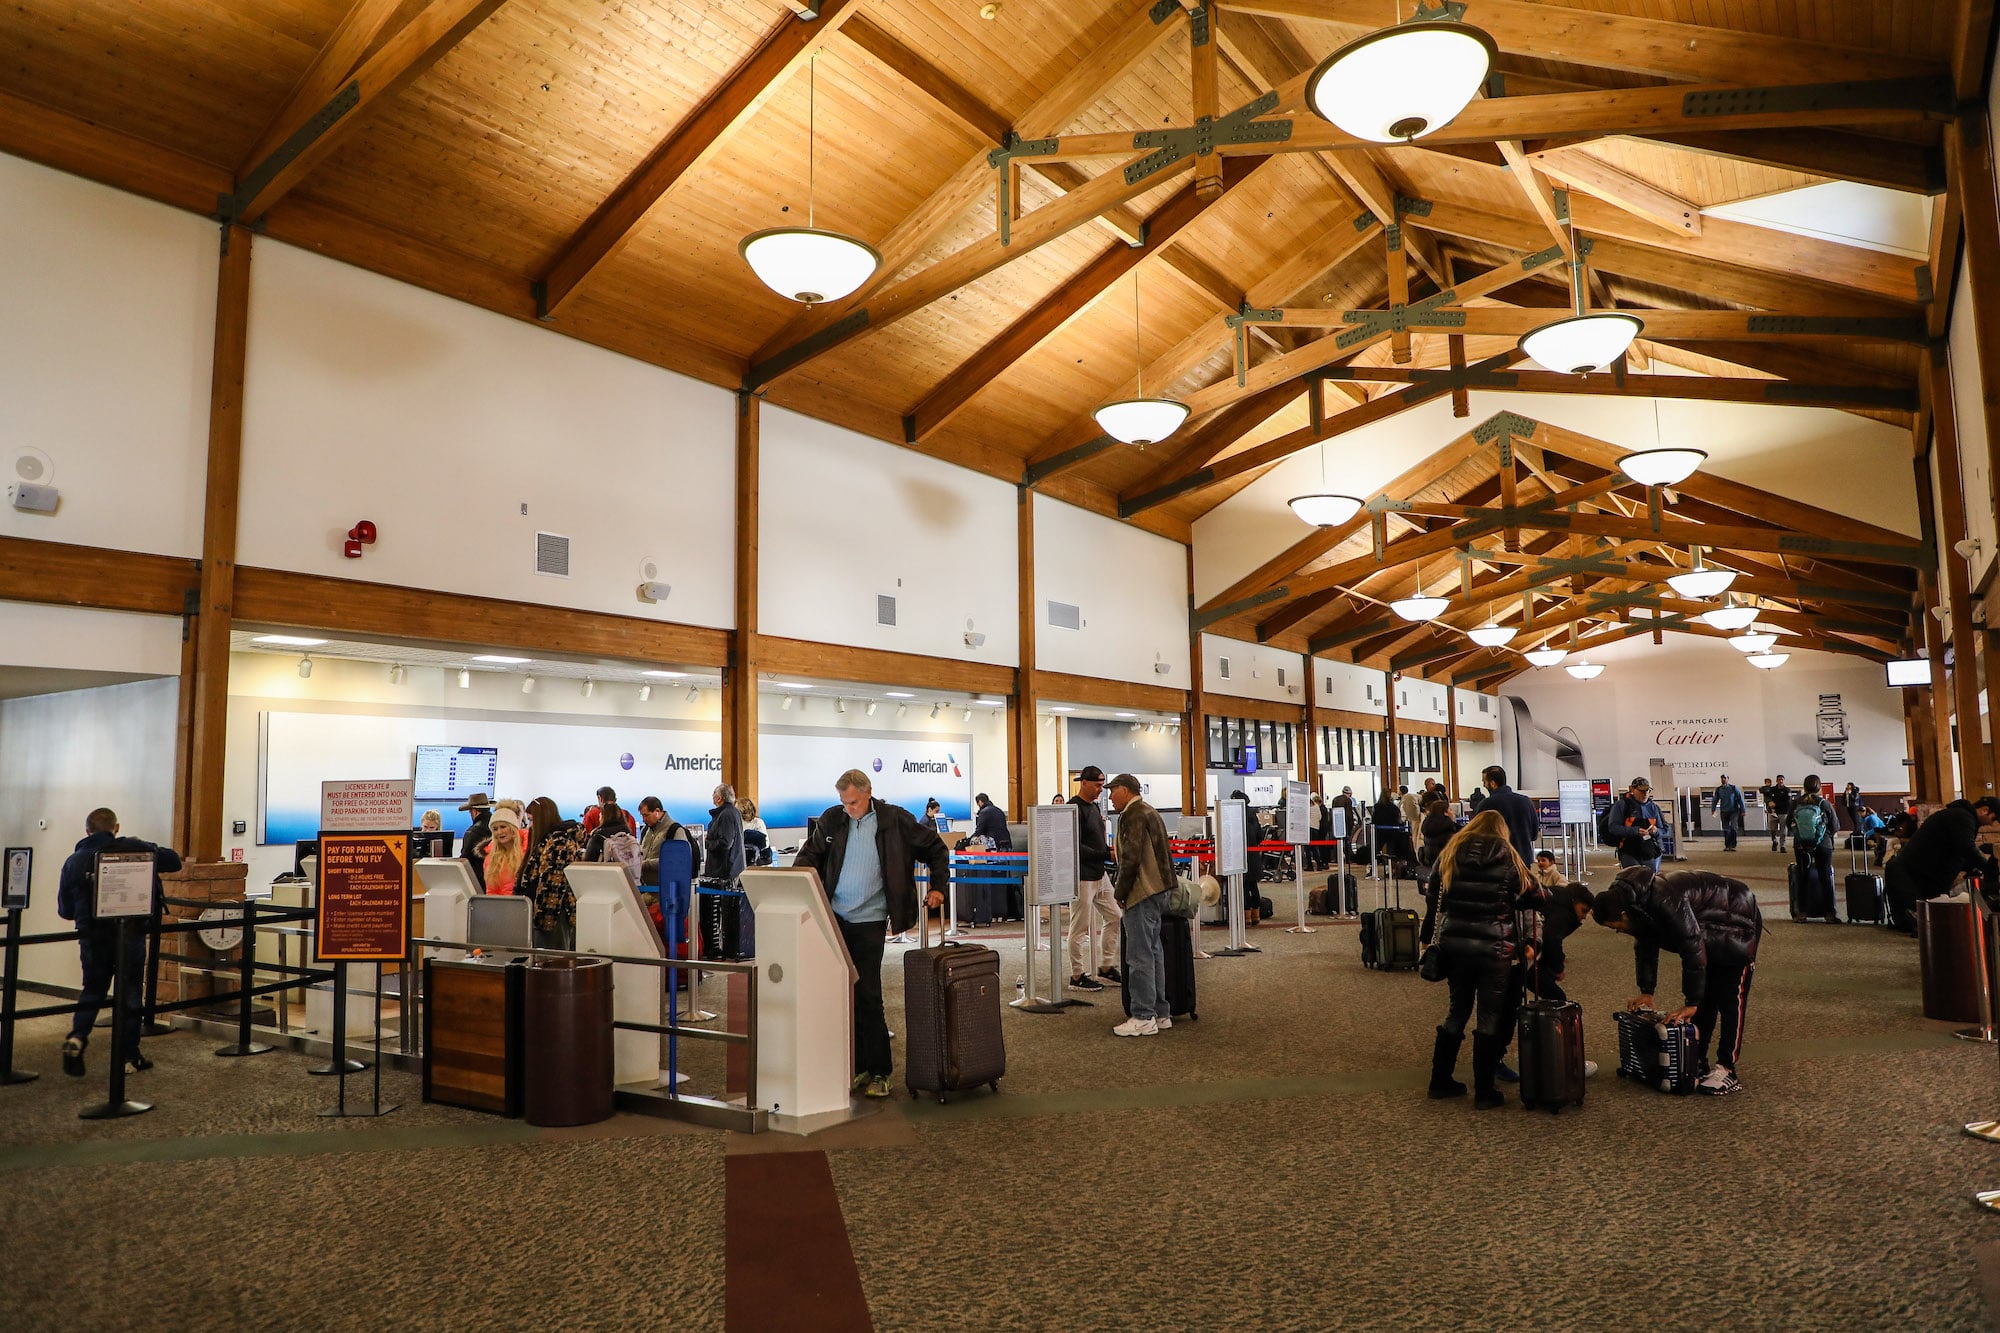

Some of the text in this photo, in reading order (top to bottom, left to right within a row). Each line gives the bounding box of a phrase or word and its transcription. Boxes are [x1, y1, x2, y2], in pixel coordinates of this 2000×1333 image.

[1656, 727, 1724, 745] Cartier
[665, 754, 722, 770] America
[902, 760, 947, 773] American
